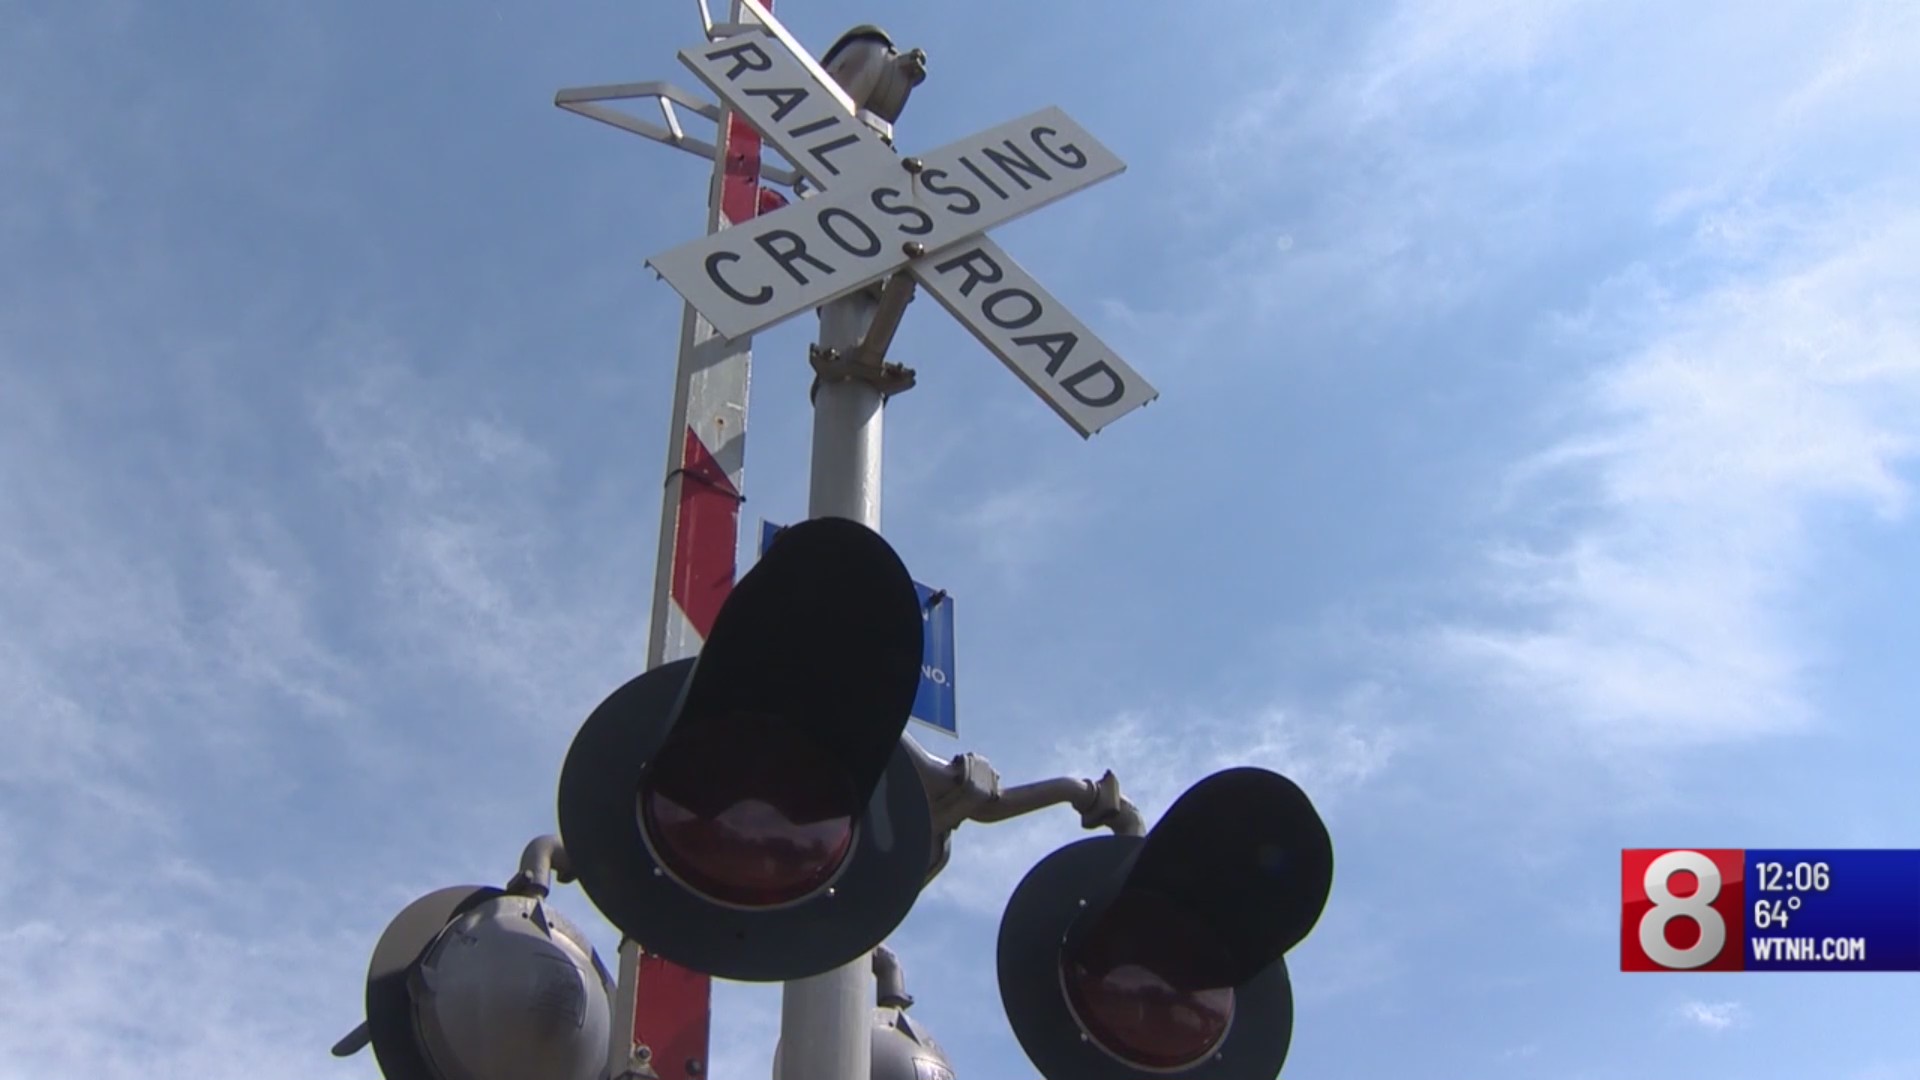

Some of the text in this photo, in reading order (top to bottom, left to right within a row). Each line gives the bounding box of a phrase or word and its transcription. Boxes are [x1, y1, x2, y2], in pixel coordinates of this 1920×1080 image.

[704, 126, 1089, 305] CROSSING
[705, 41, 1126, 408] RAIL ROAD
